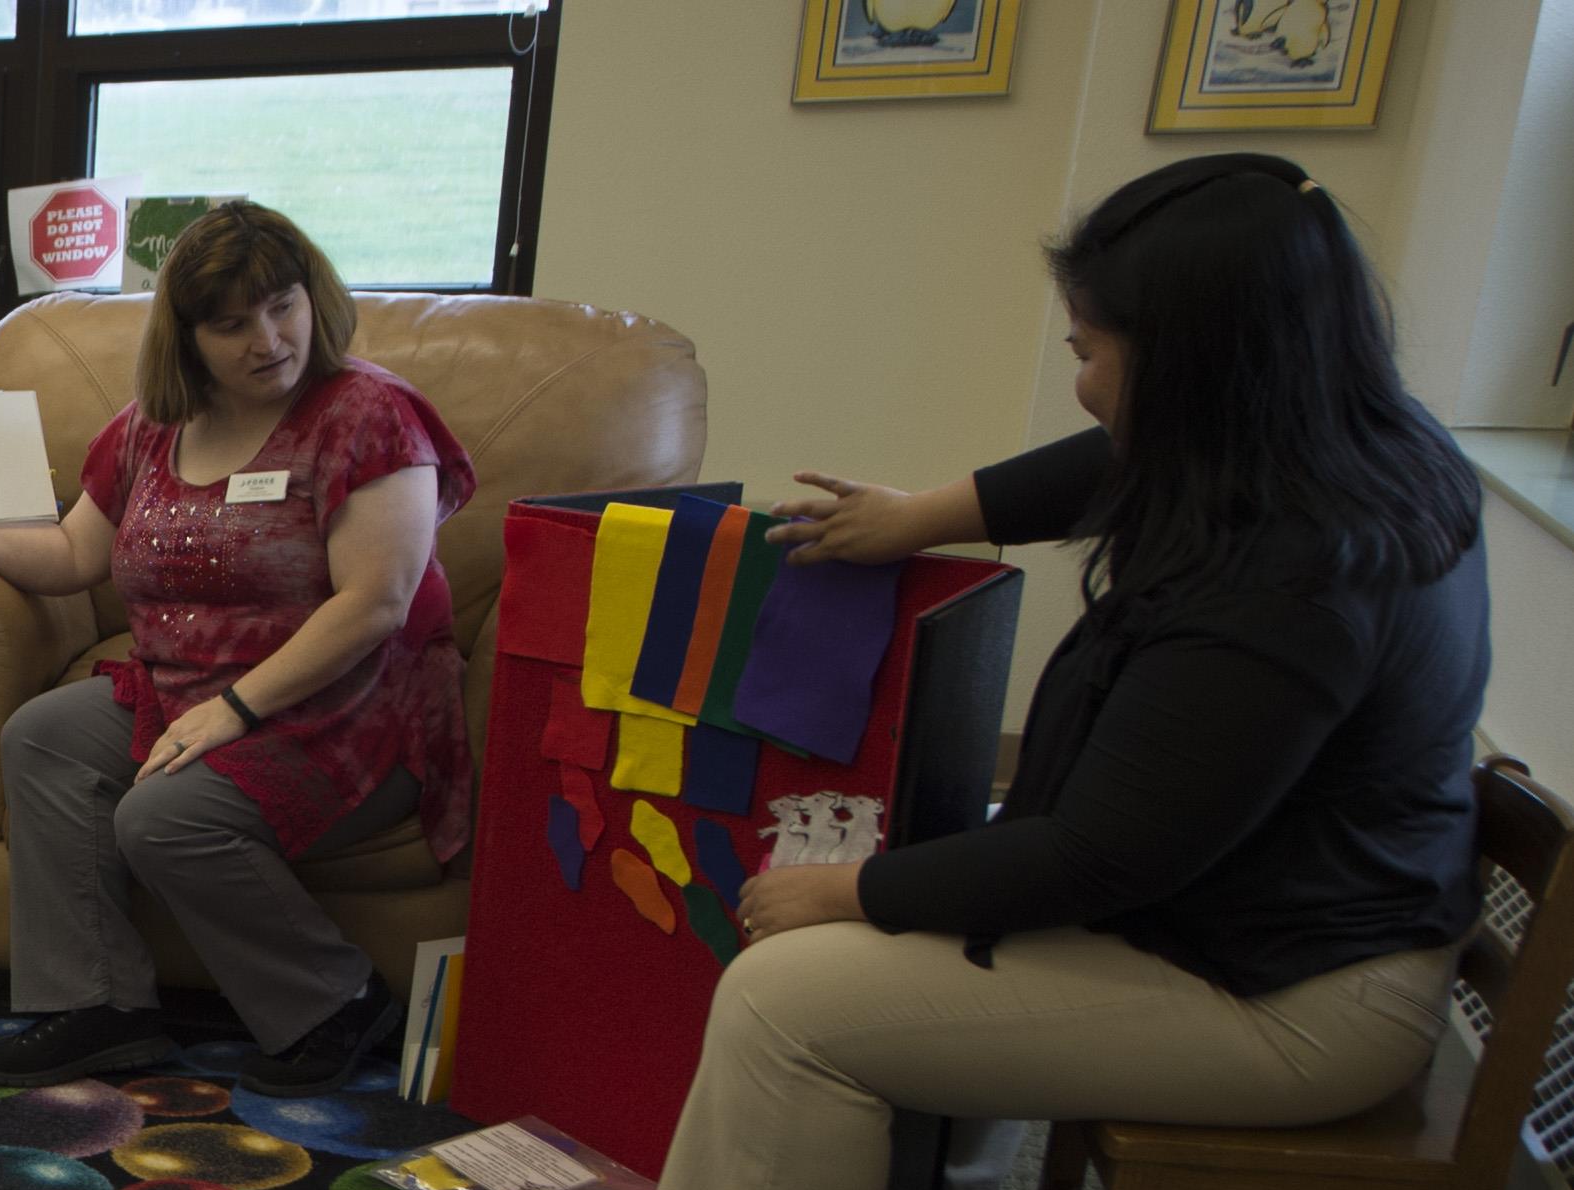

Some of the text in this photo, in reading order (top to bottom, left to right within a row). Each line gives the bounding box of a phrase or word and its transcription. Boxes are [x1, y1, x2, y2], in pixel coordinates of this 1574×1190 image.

[46, 204, 103, 222] PLEASE
[46, 218, 103, 237] DO NOT
[53, 233, 96, 249] OPEN
[42, 245, 109, 264] WINDOW
